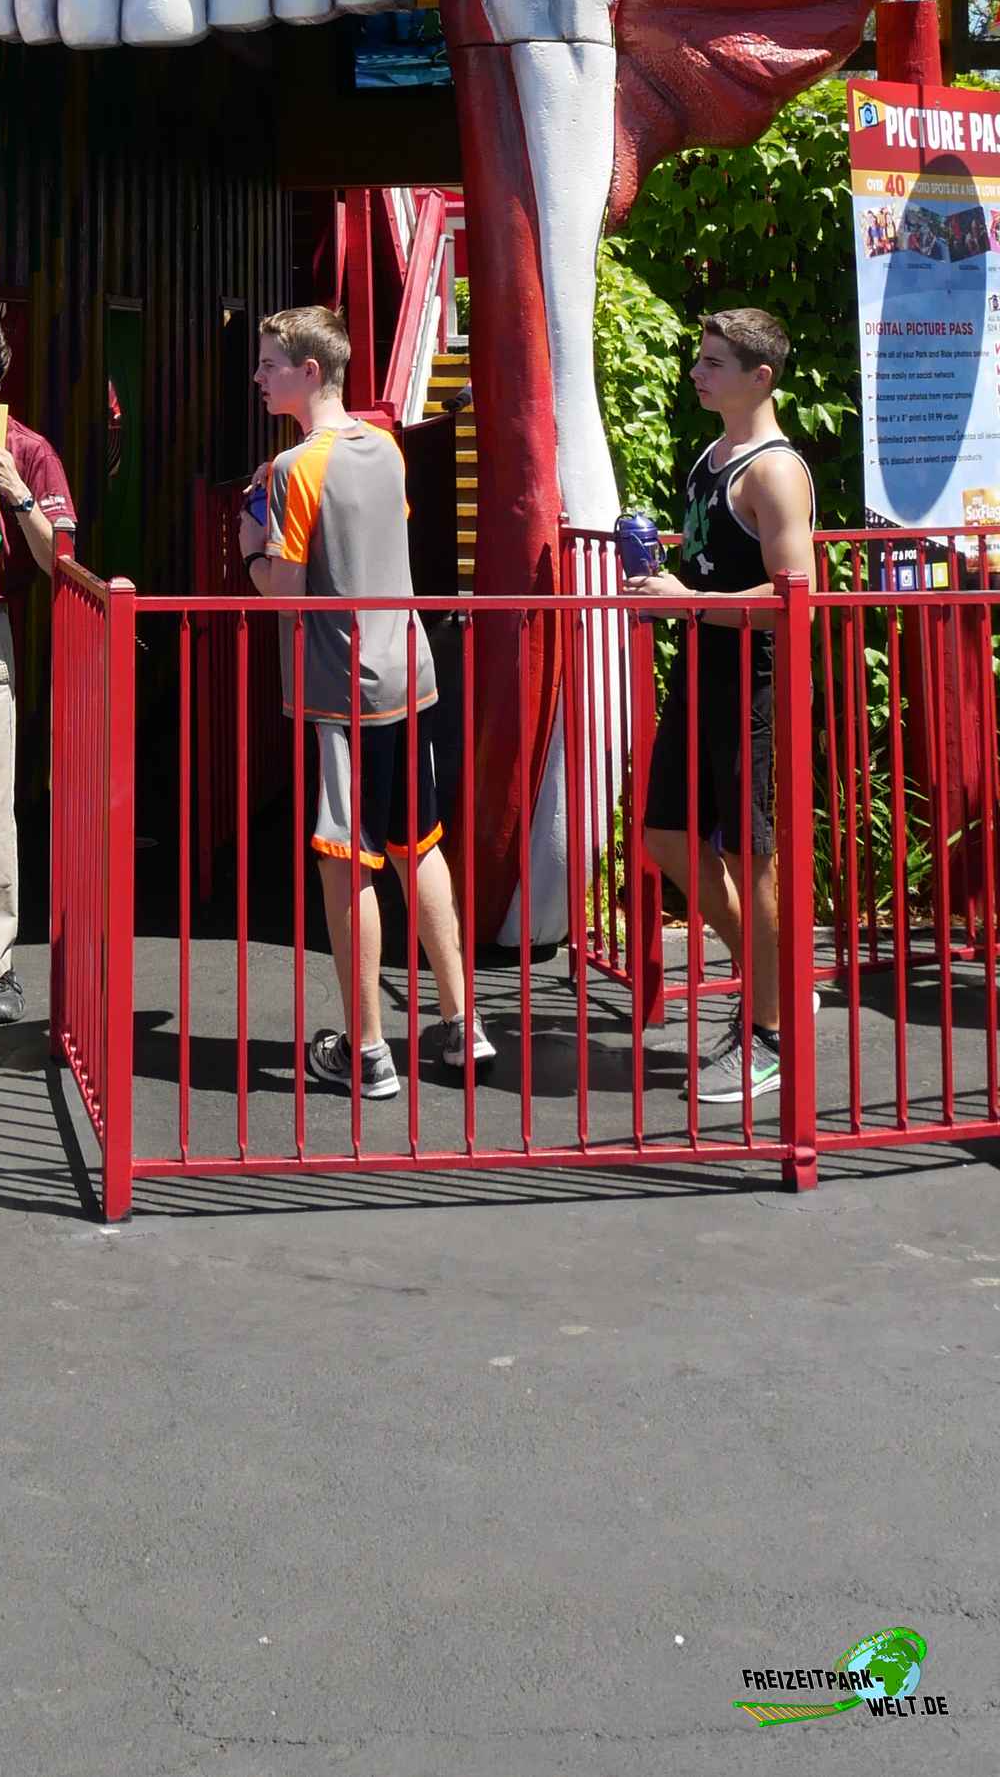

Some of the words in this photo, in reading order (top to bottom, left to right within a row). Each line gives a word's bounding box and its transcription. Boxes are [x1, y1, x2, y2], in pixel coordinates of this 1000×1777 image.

[885, 105, 966, 151] PICTURE
[885, 174, 905, 198] 40
[864, 321, 904, 336] DIGITAL
[906, 321, 947, 336] PICTURE
[949, 322, 974, 335] PASS
